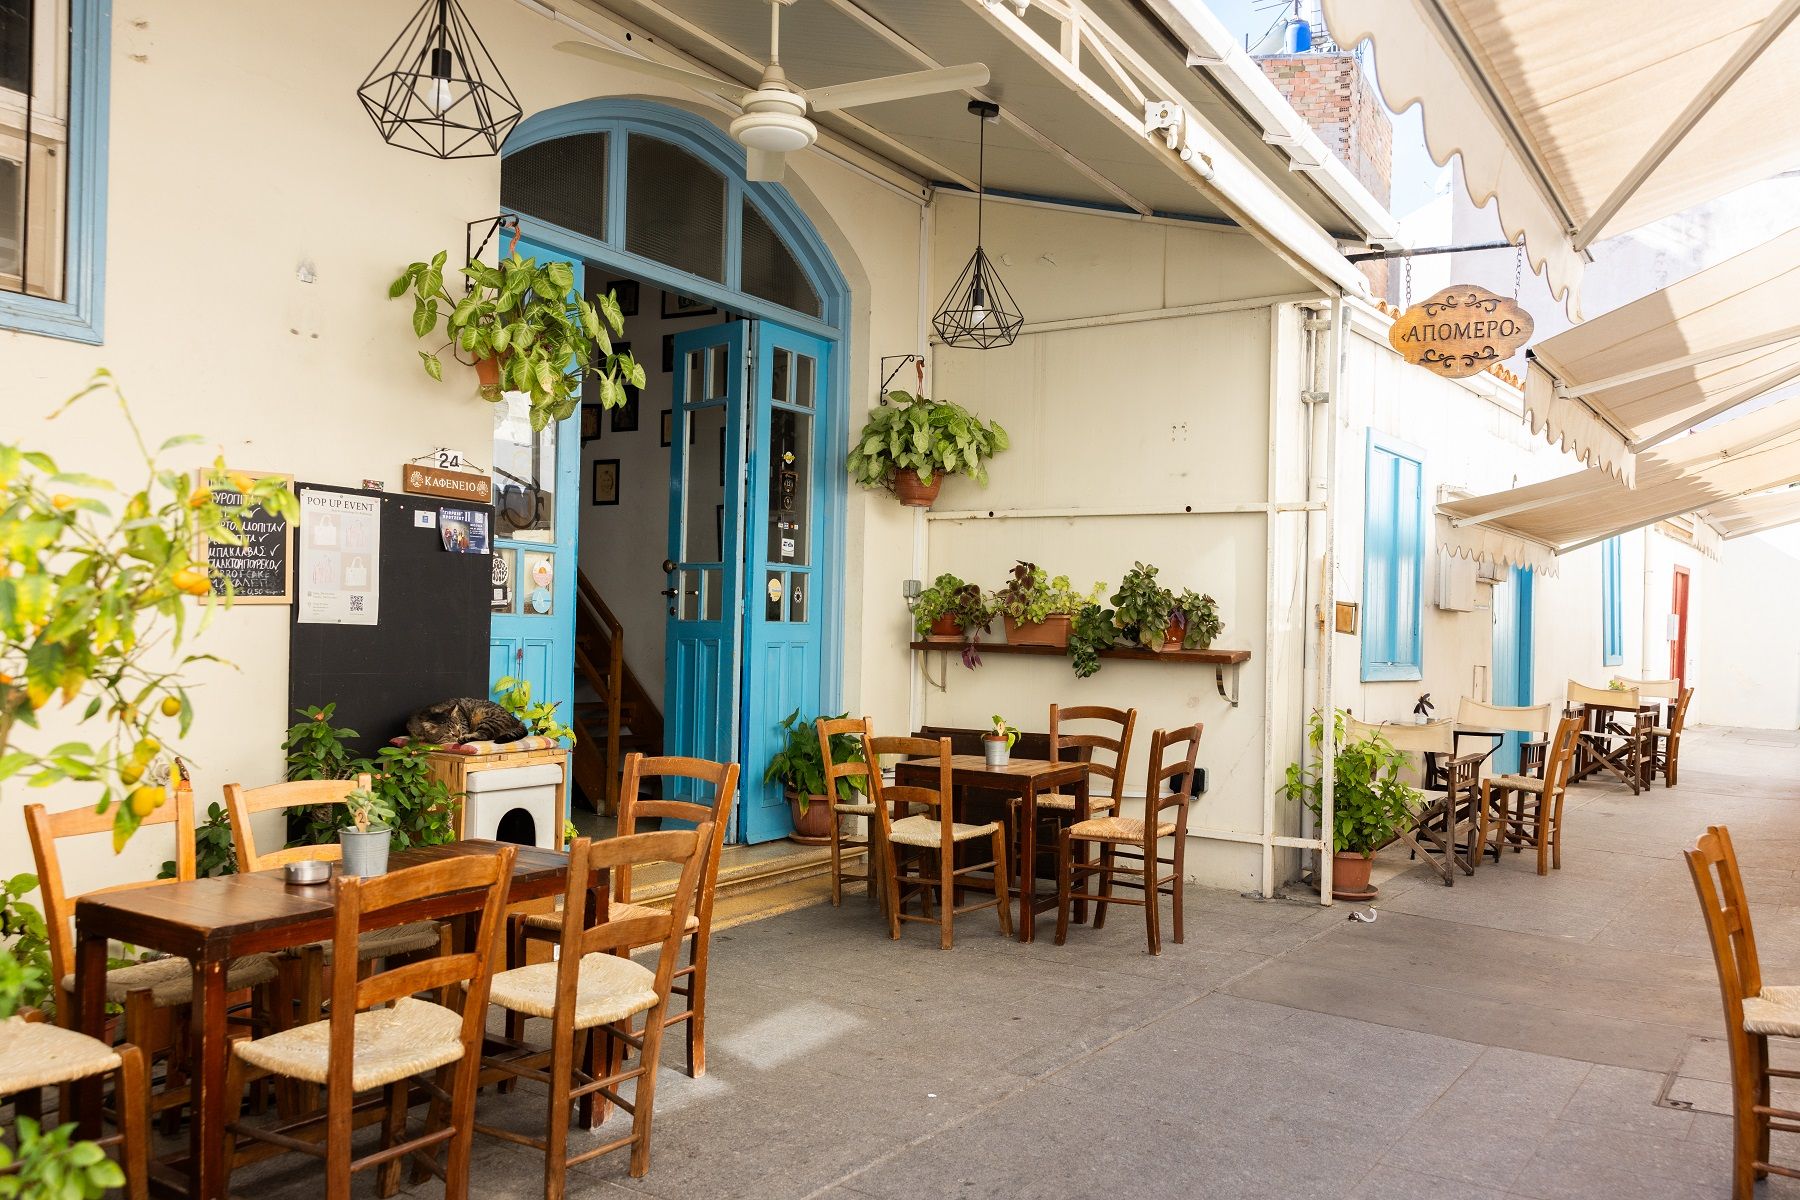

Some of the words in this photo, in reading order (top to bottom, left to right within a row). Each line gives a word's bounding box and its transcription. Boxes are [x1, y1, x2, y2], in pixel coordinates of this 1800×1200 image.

[439, 452, 460, 469] 24
[424, 475, 476, 492] ΚΑΦΕΝΕΙΟ
[307, 496, 327, 507] POP
[329, 498, 342, 508] UP
[344, 500, 374, 512] EVENT
[357, 812, 365, 824] 2
